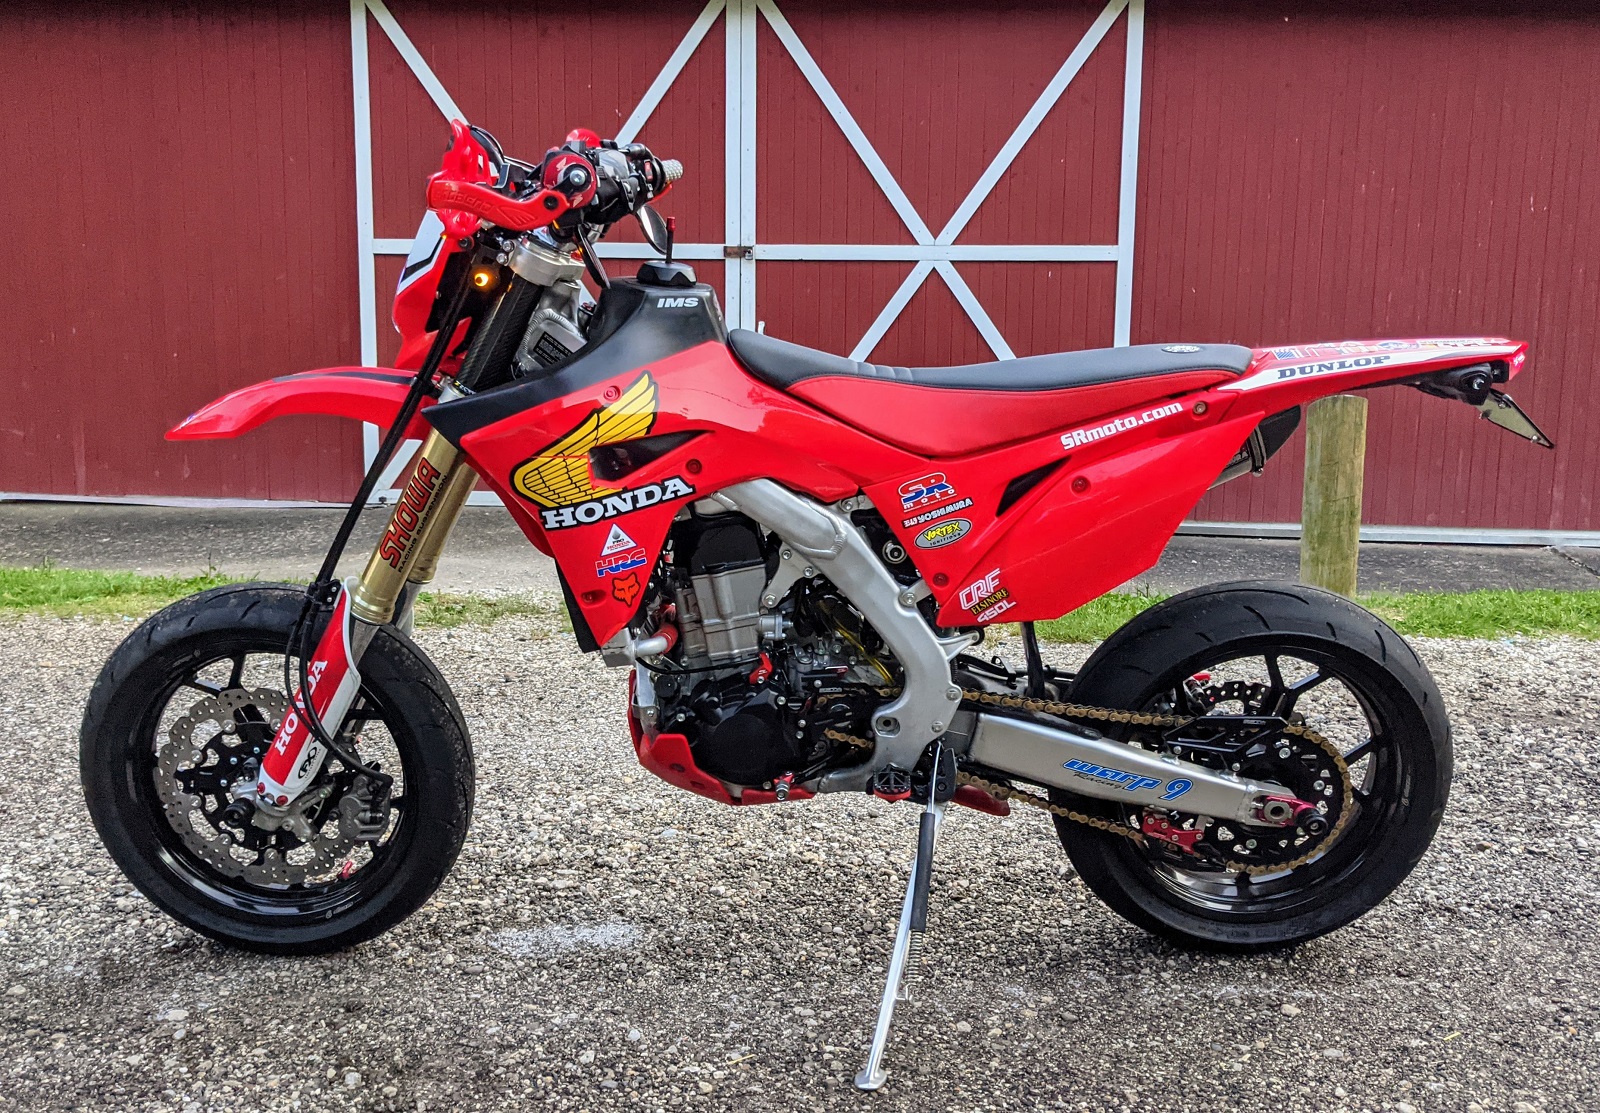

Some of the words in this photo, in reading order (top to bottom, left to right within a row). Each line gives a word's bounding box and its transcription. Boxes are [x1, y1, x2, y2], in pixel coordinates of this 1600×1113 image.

[657, 297, 699, 308] IMS
[1277, 355, 1391, 380] DUNLOP
[1060, 402, 1184, 450] SRmoto.com
[541, 476, 694, 529] HONDA
[898, 472, 953, 505] SR
[903, 488, 955, 510] moto
[380, 456, 442, 570] SHOWA
[398, 537, 418, 573] RACING
[416, 475, 448, 536] SUSPENSION
[917, 498, 973, 524] YOSHIMURA
[923, 521, 962, 541] VORTEX
[594, 547, 648, 578] HRC
[958, 567, 1001, 610] CRF
[970, 587, 1010, 615] ELSINORE
[976, 599, 1017, 623] 450L
[1158, 778, 1194, 801] 9
